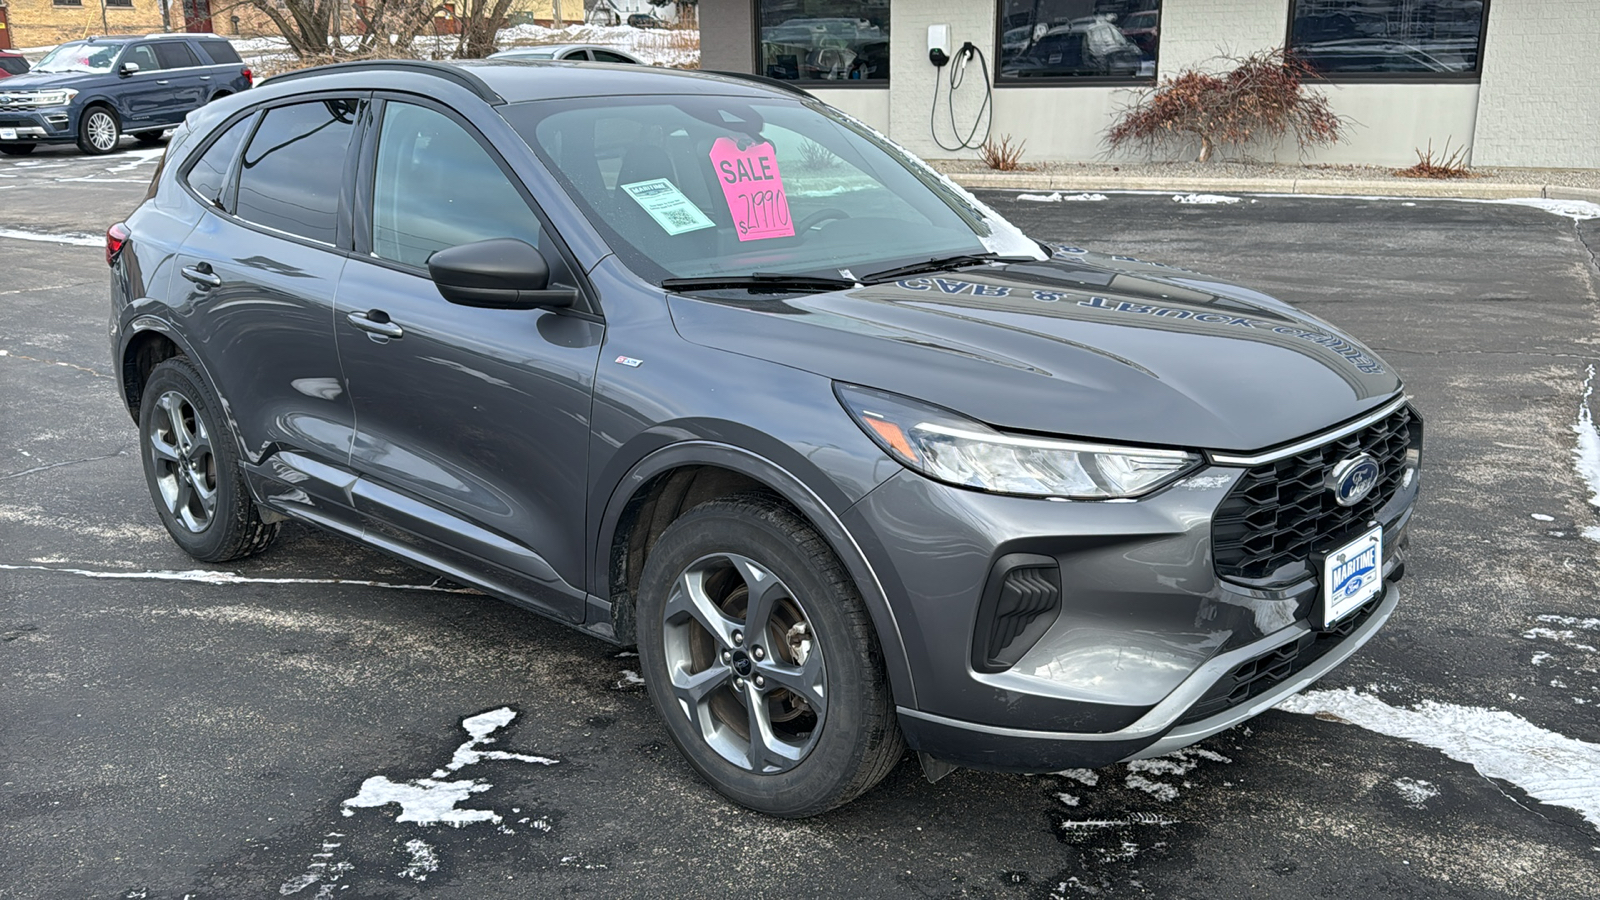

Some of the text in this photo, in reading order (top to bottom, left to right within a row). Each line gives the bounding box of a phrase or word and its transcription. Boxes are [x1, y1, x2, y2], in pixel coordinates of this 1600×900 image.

[720, 156, 774, 184] SALE
[1348, 467, 1374, 498] Ford
[1333, 547, 1375, 591] MARITIME
